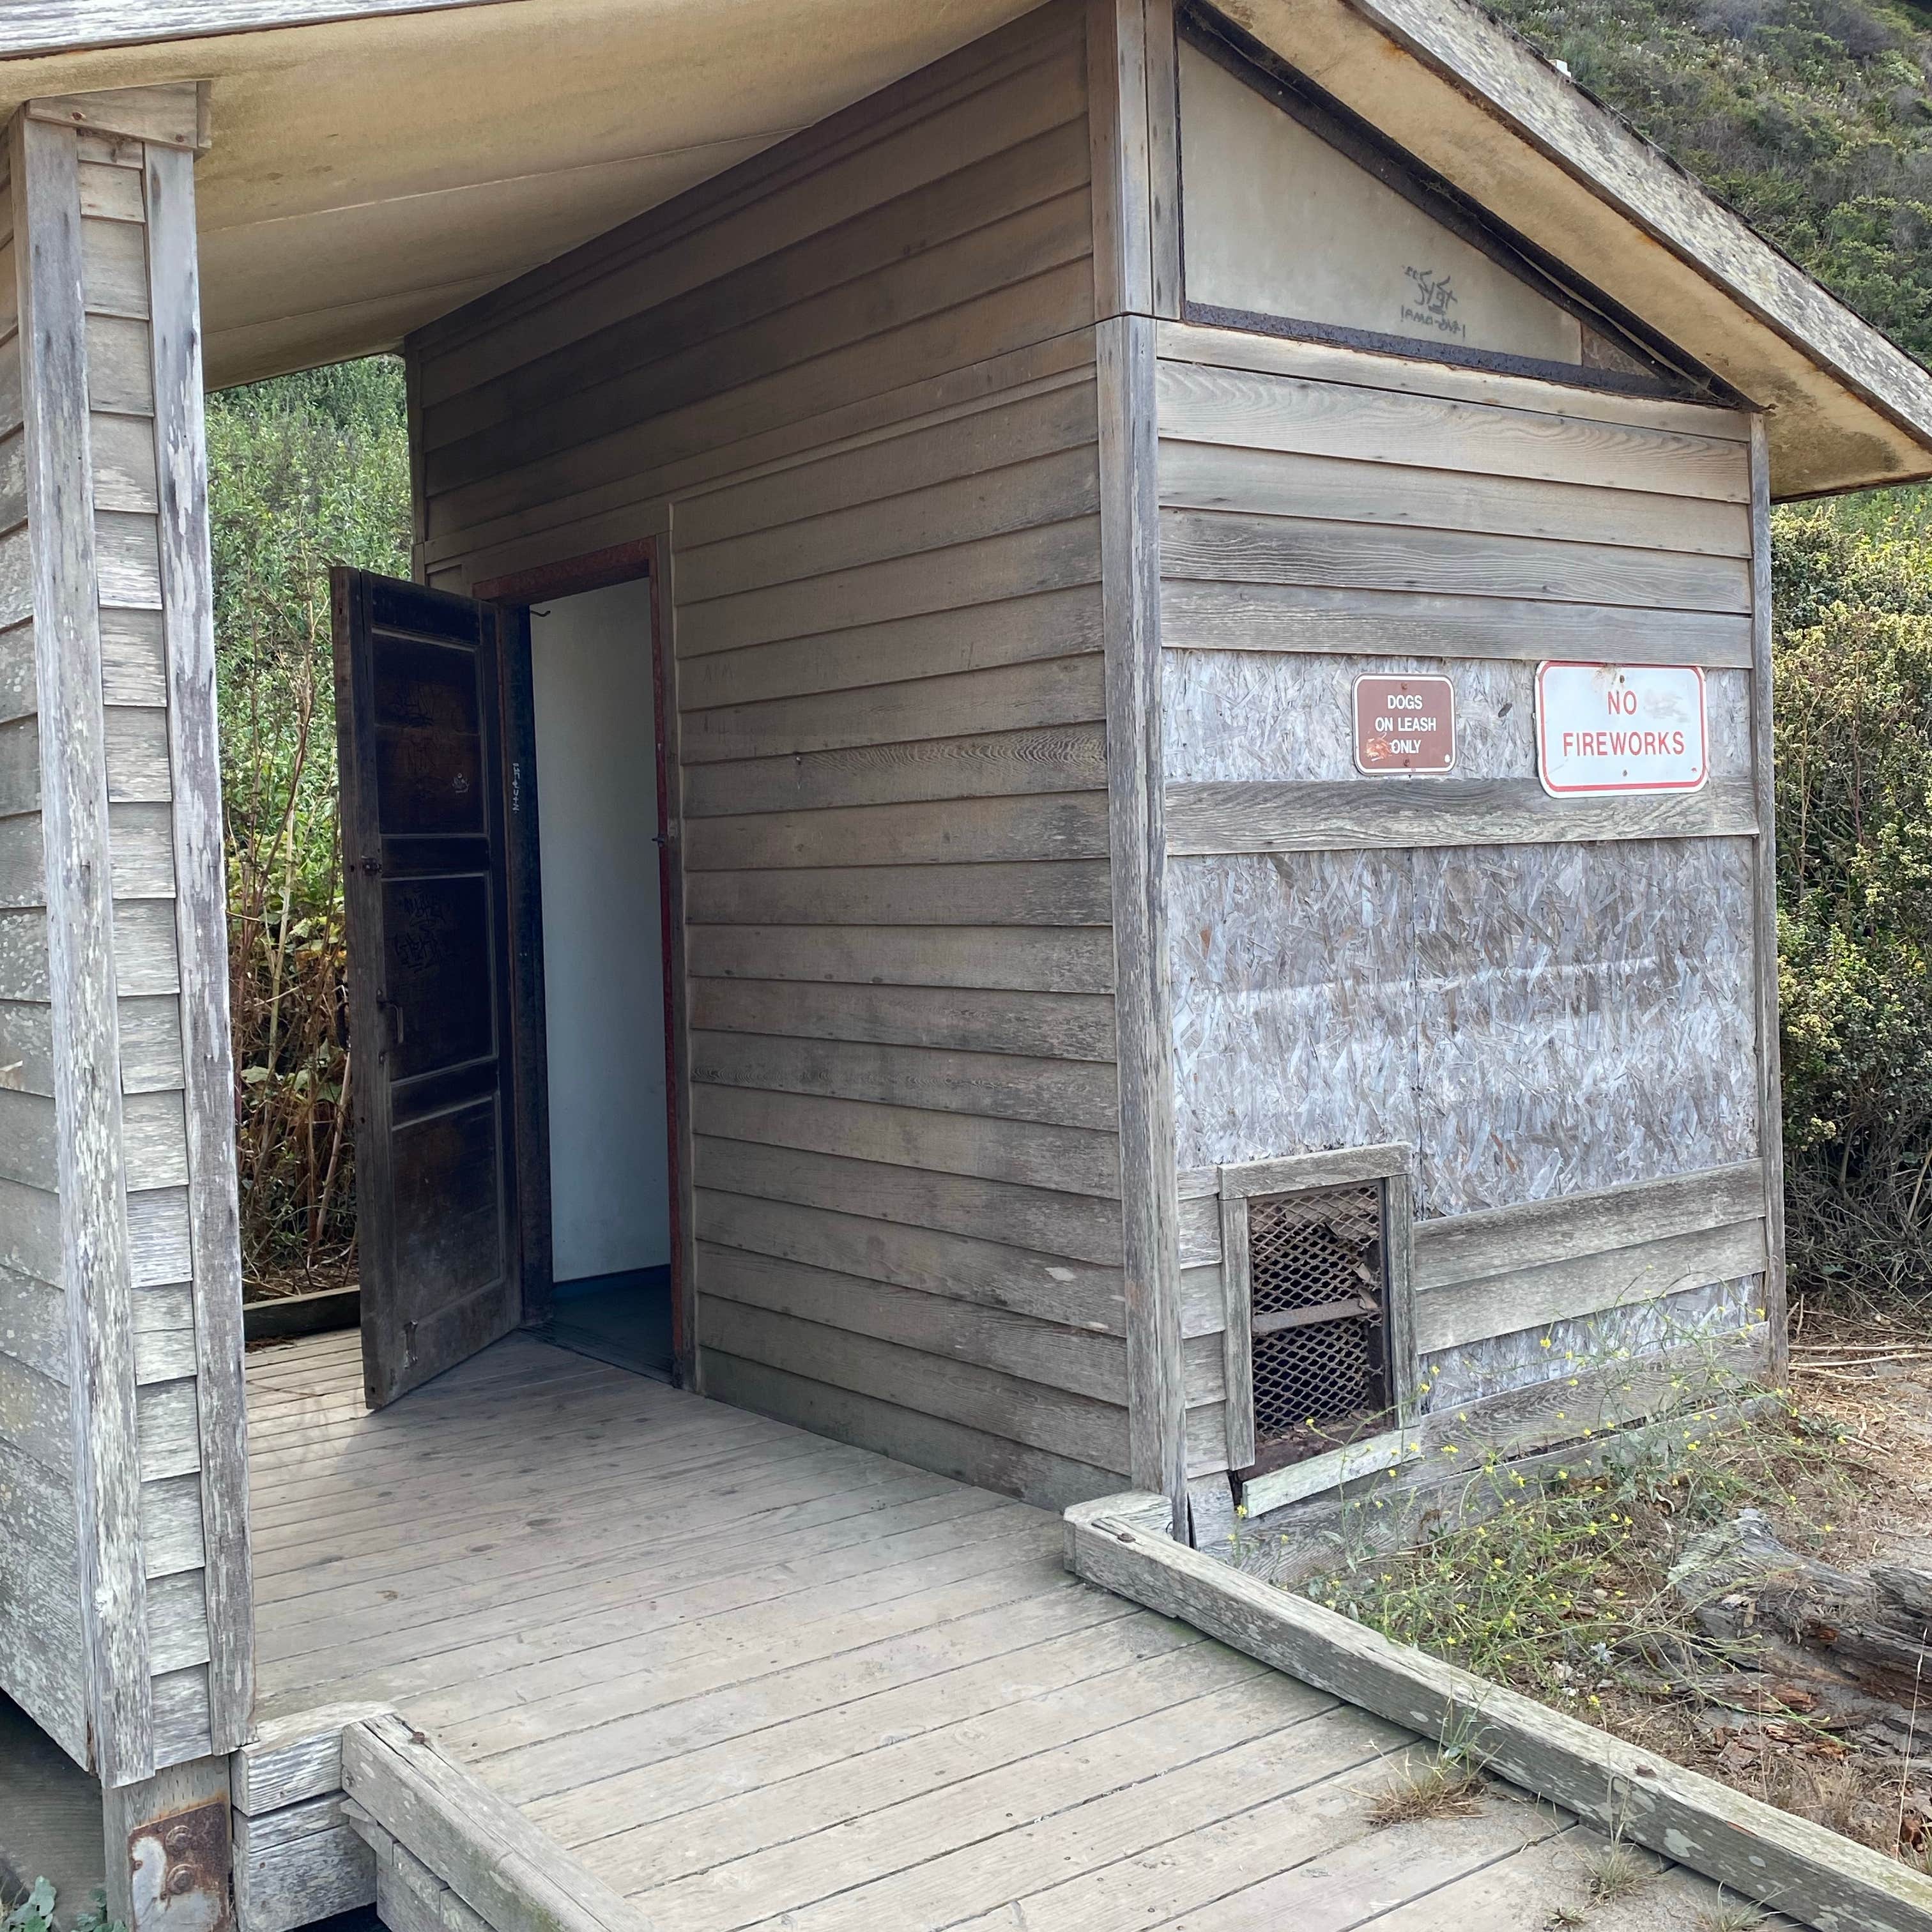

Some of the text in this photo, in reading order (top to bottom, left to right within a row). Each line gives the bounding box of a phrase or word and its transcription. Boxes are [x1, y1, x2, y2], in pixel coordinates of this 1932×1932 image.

[1387, 694, 1423, 710] DOGS
[1607, 689, 1637, 716] NO
[1375, 717, 1436, 732] ON LEASH
[1391, 739, 1422, 755] ONLY
[1563, 731, 1685, 757] FIREWORKS
